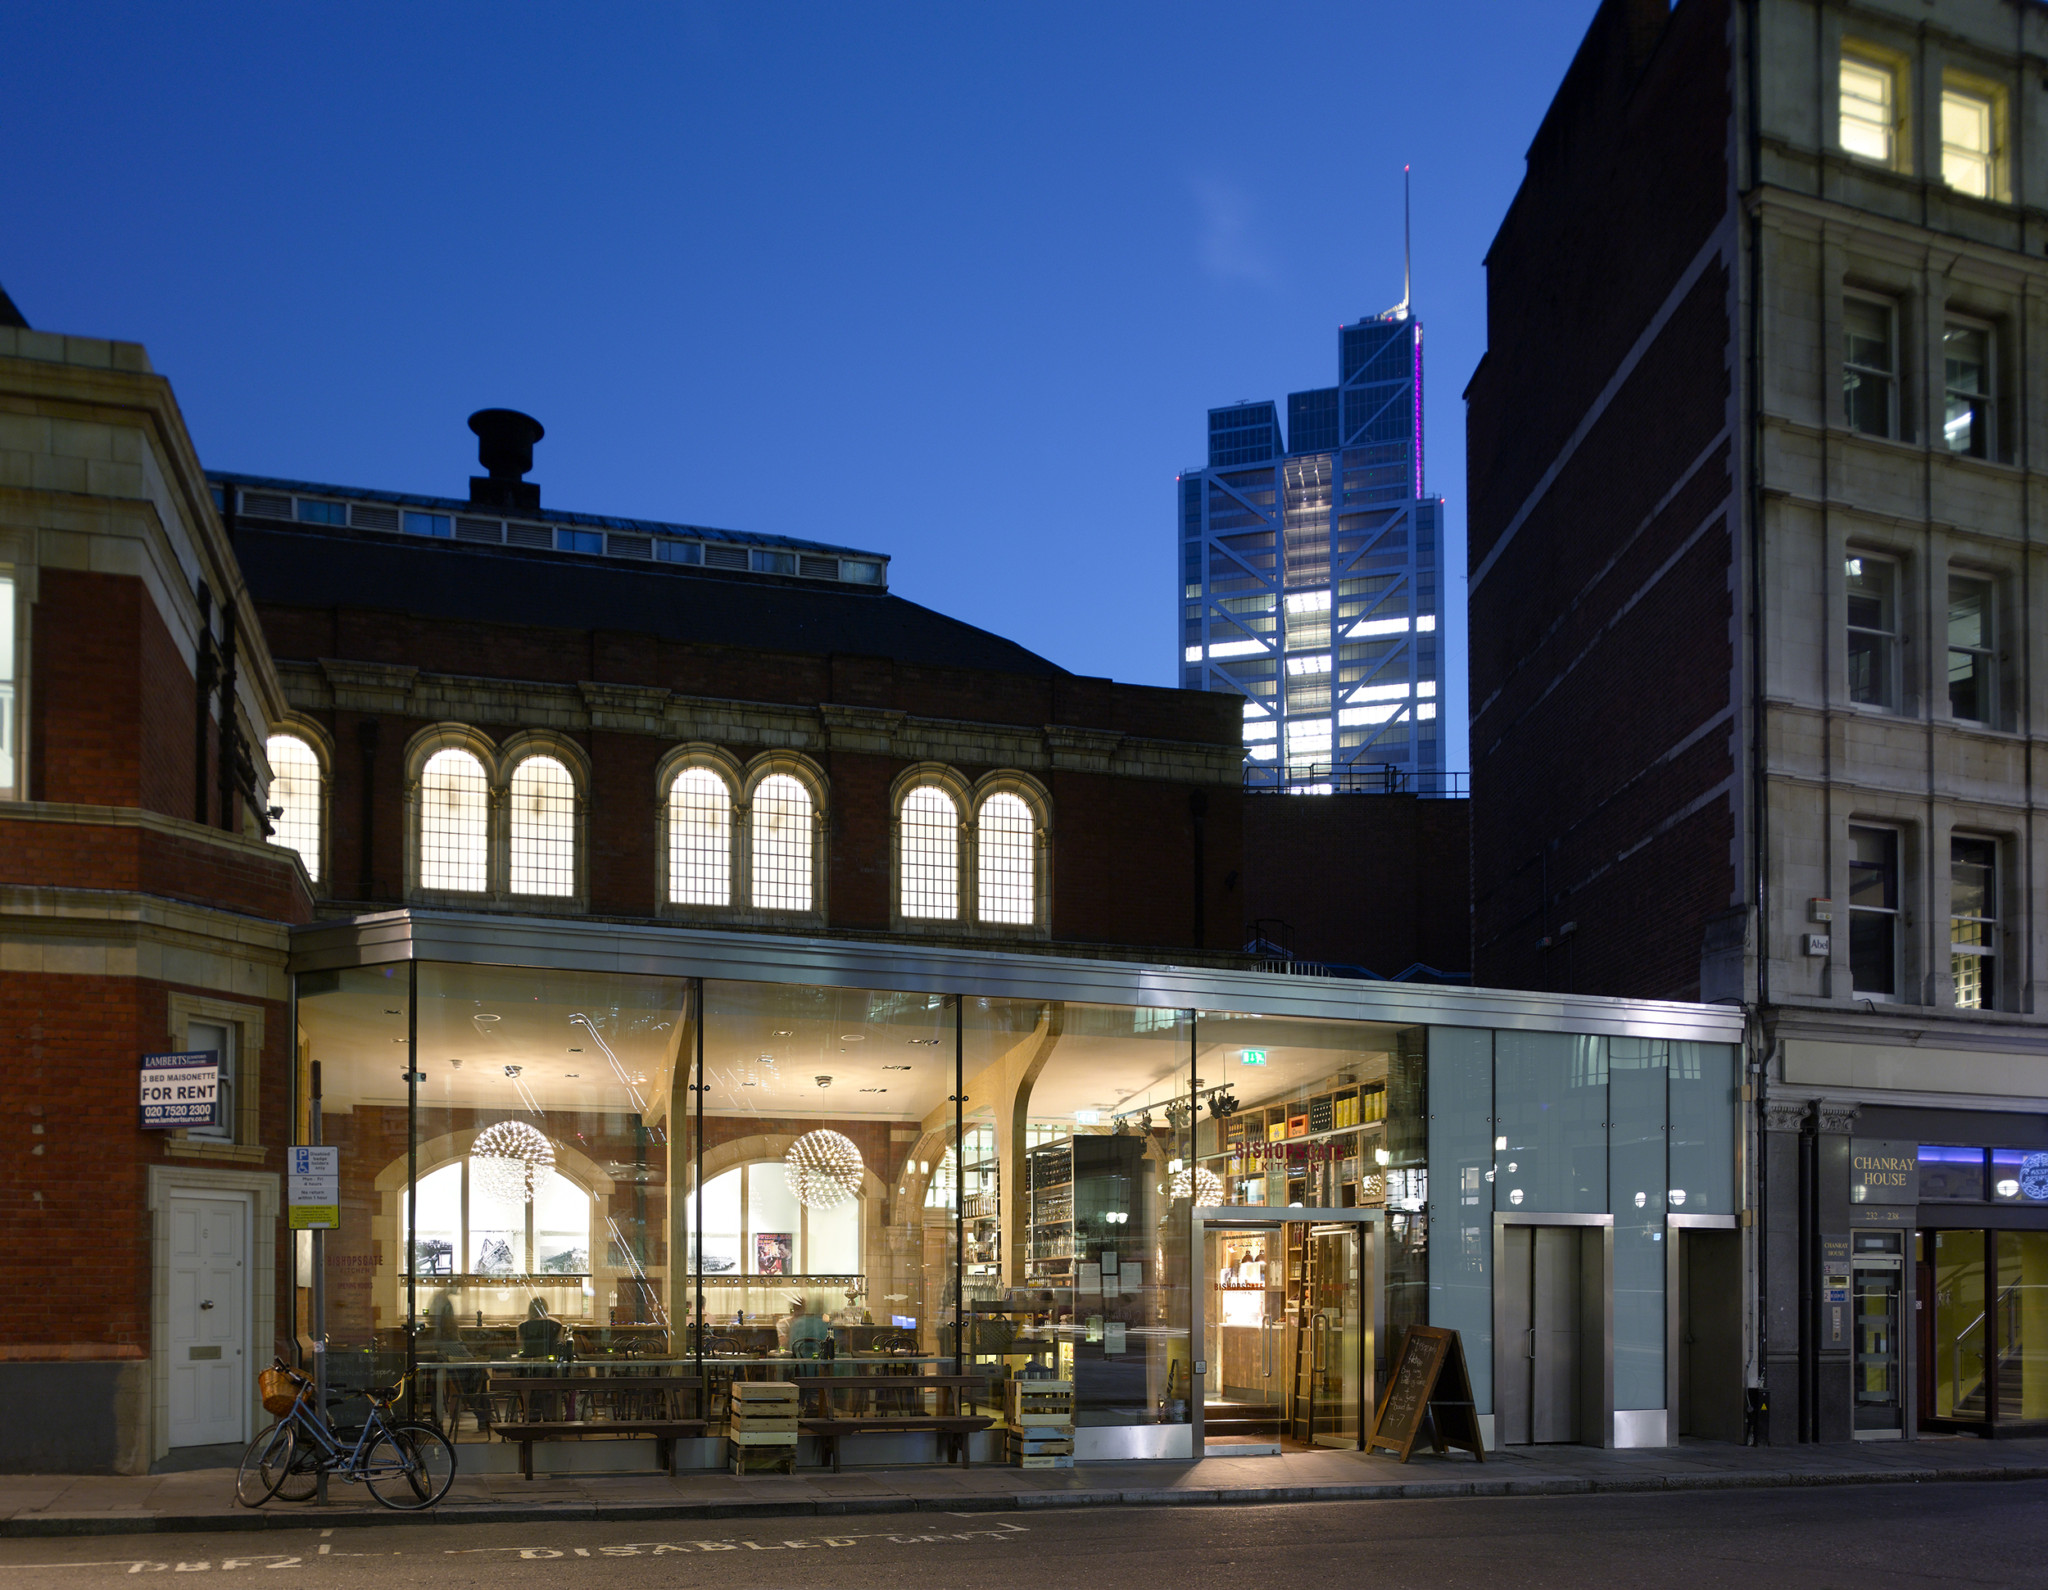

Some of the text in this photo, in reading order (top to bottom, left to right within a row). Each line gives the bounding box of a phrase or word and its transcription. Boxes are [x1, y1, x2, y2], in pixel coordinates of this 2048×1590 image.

[1811, 938, 1829, 950] Abel
[145, 1056, 187, 1066] LAMBERTS
[166, 1072, 216, 1081] MAISONETTE
[142, 1085, 216, 1100] FOR RENT
[145, 1104, 211, 1117] 020 7520 2300
[299, 1149, 307, 1160] P
[1235, 1141, 1345, 1160] BISHOPSGATE
[1854, 1156, 1916, 1171] CHANRAY
[1864, 1172, 1907, 1186] HOUSE
[1865, 1211, 1878, 1220] 232
[327, 1255, 384, 1266] BISHOPSGATE
[1214, 1282, 1265, 1291] BISHOPSGATE
[519, 1538, 857, 1559] DISABLED
